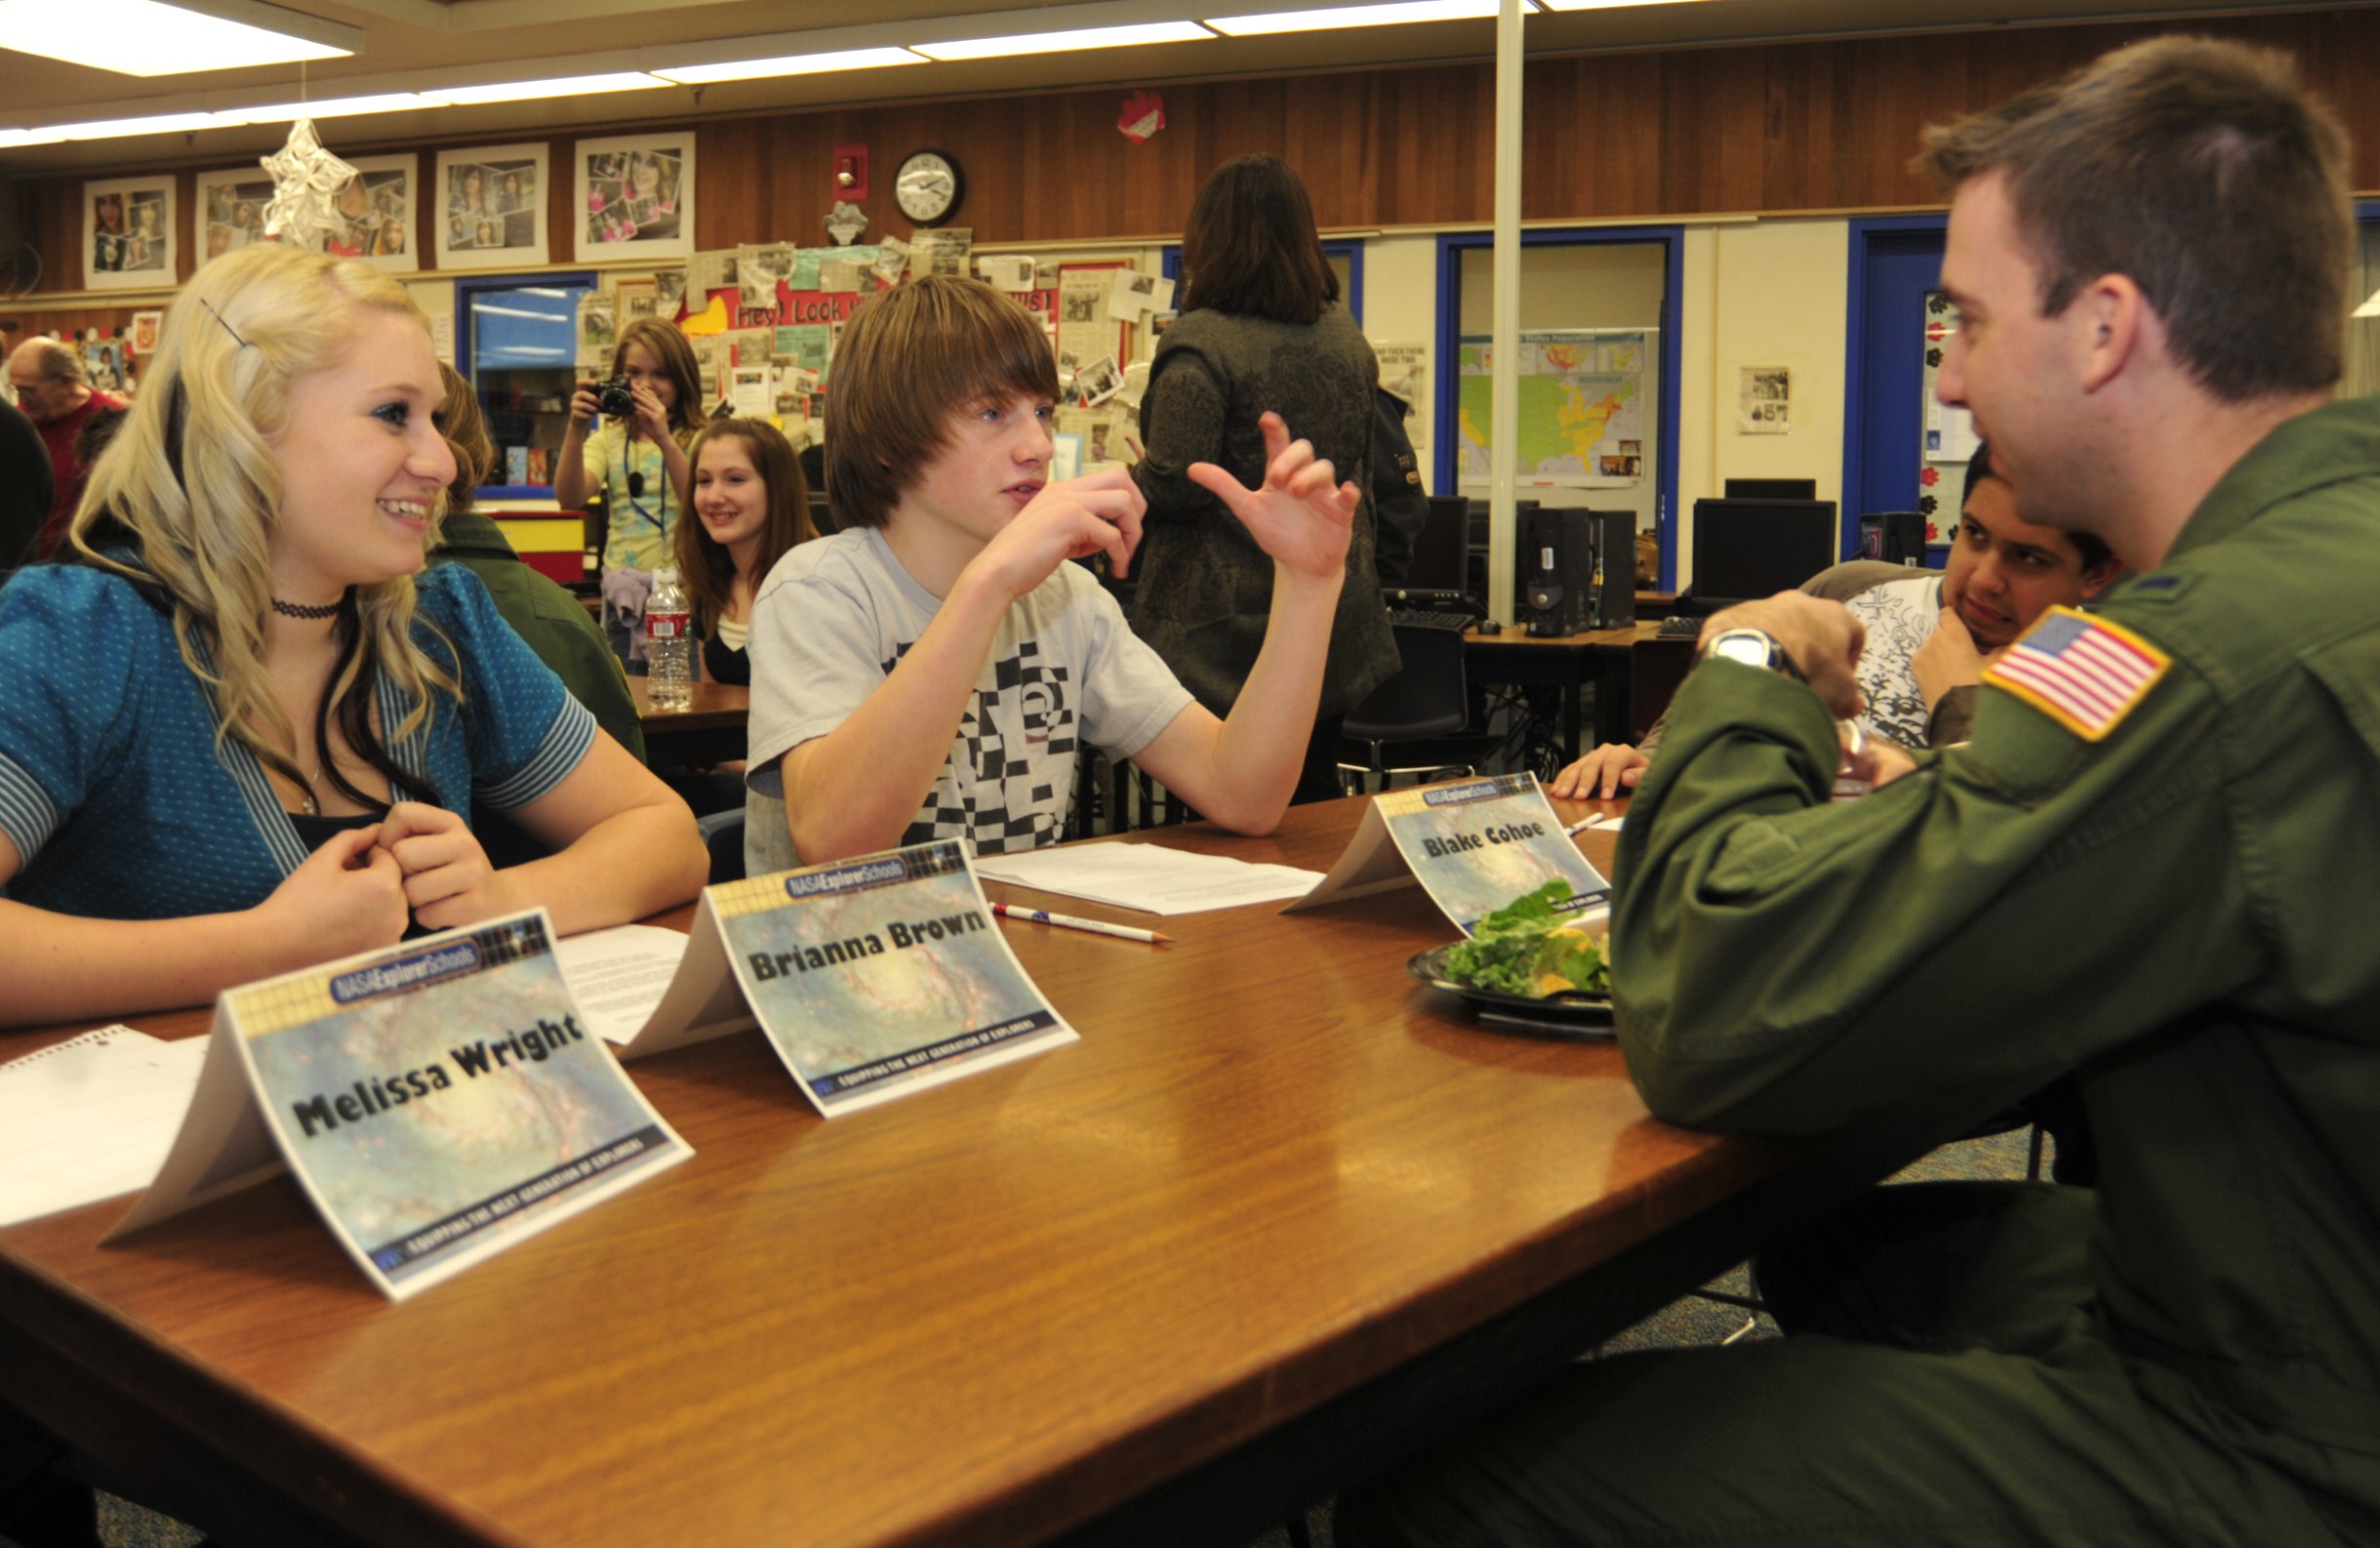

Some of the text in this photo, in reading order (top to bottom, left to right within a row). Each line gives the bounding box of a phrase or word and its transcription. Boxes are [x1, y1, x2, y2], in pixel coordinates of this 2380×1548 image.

[792, 295, 842, 324] Look
[1406, 346, 1425, 355] THERE
[1553, 332, 1595, 341] Population
[1382, 355, 1416, 364] WERE TWO
[1422, 821, 1545, 858] Blake Cohoe
[748, 910, 987, 982] Brianna Brown
[886, 1059, 907, 1074] THE
[905, 1050, 930, 1067] NEXT
[928, 1036, 980, 1059] GENERATION
[989, 1019, 1036, 1039] EXPLORERS
[292, 1012, 584, 1138] Melissa Wright
[590, 1137, 645, 1169] EXPLORERS
